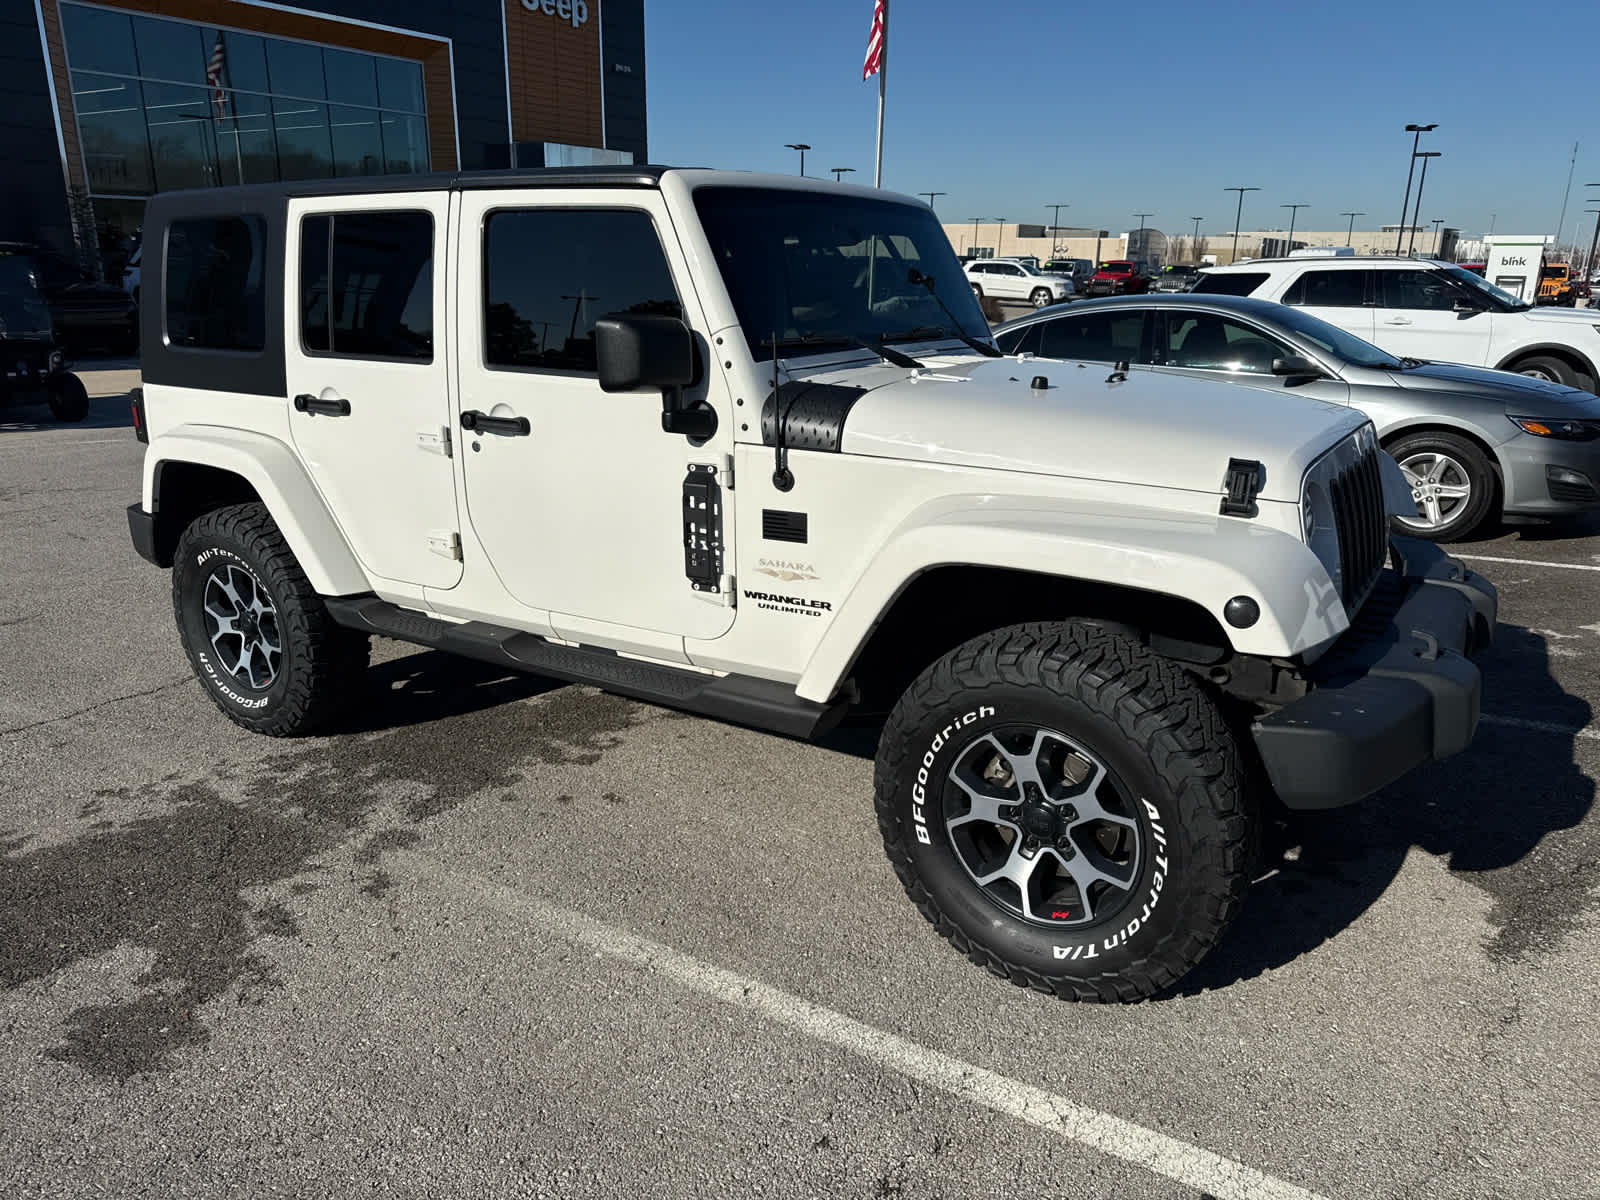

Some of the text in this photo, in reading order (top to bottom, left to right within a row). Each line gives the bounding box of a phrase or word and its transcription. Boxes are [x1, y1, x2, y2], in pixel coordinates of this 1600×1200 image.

[1501, 256, 1527, 266] blink
[758, 558, 816, 573] SAHARA
[743, 590, 832, 612] WRANGLER
[757, 602, 822, 617] UNLIMITED
[199, 652, 269, 709] BFGoodrich
[912, 705, 996, 846] BFGoodrich
[1052, 797, 1169, 961] All-Terrain T/A
